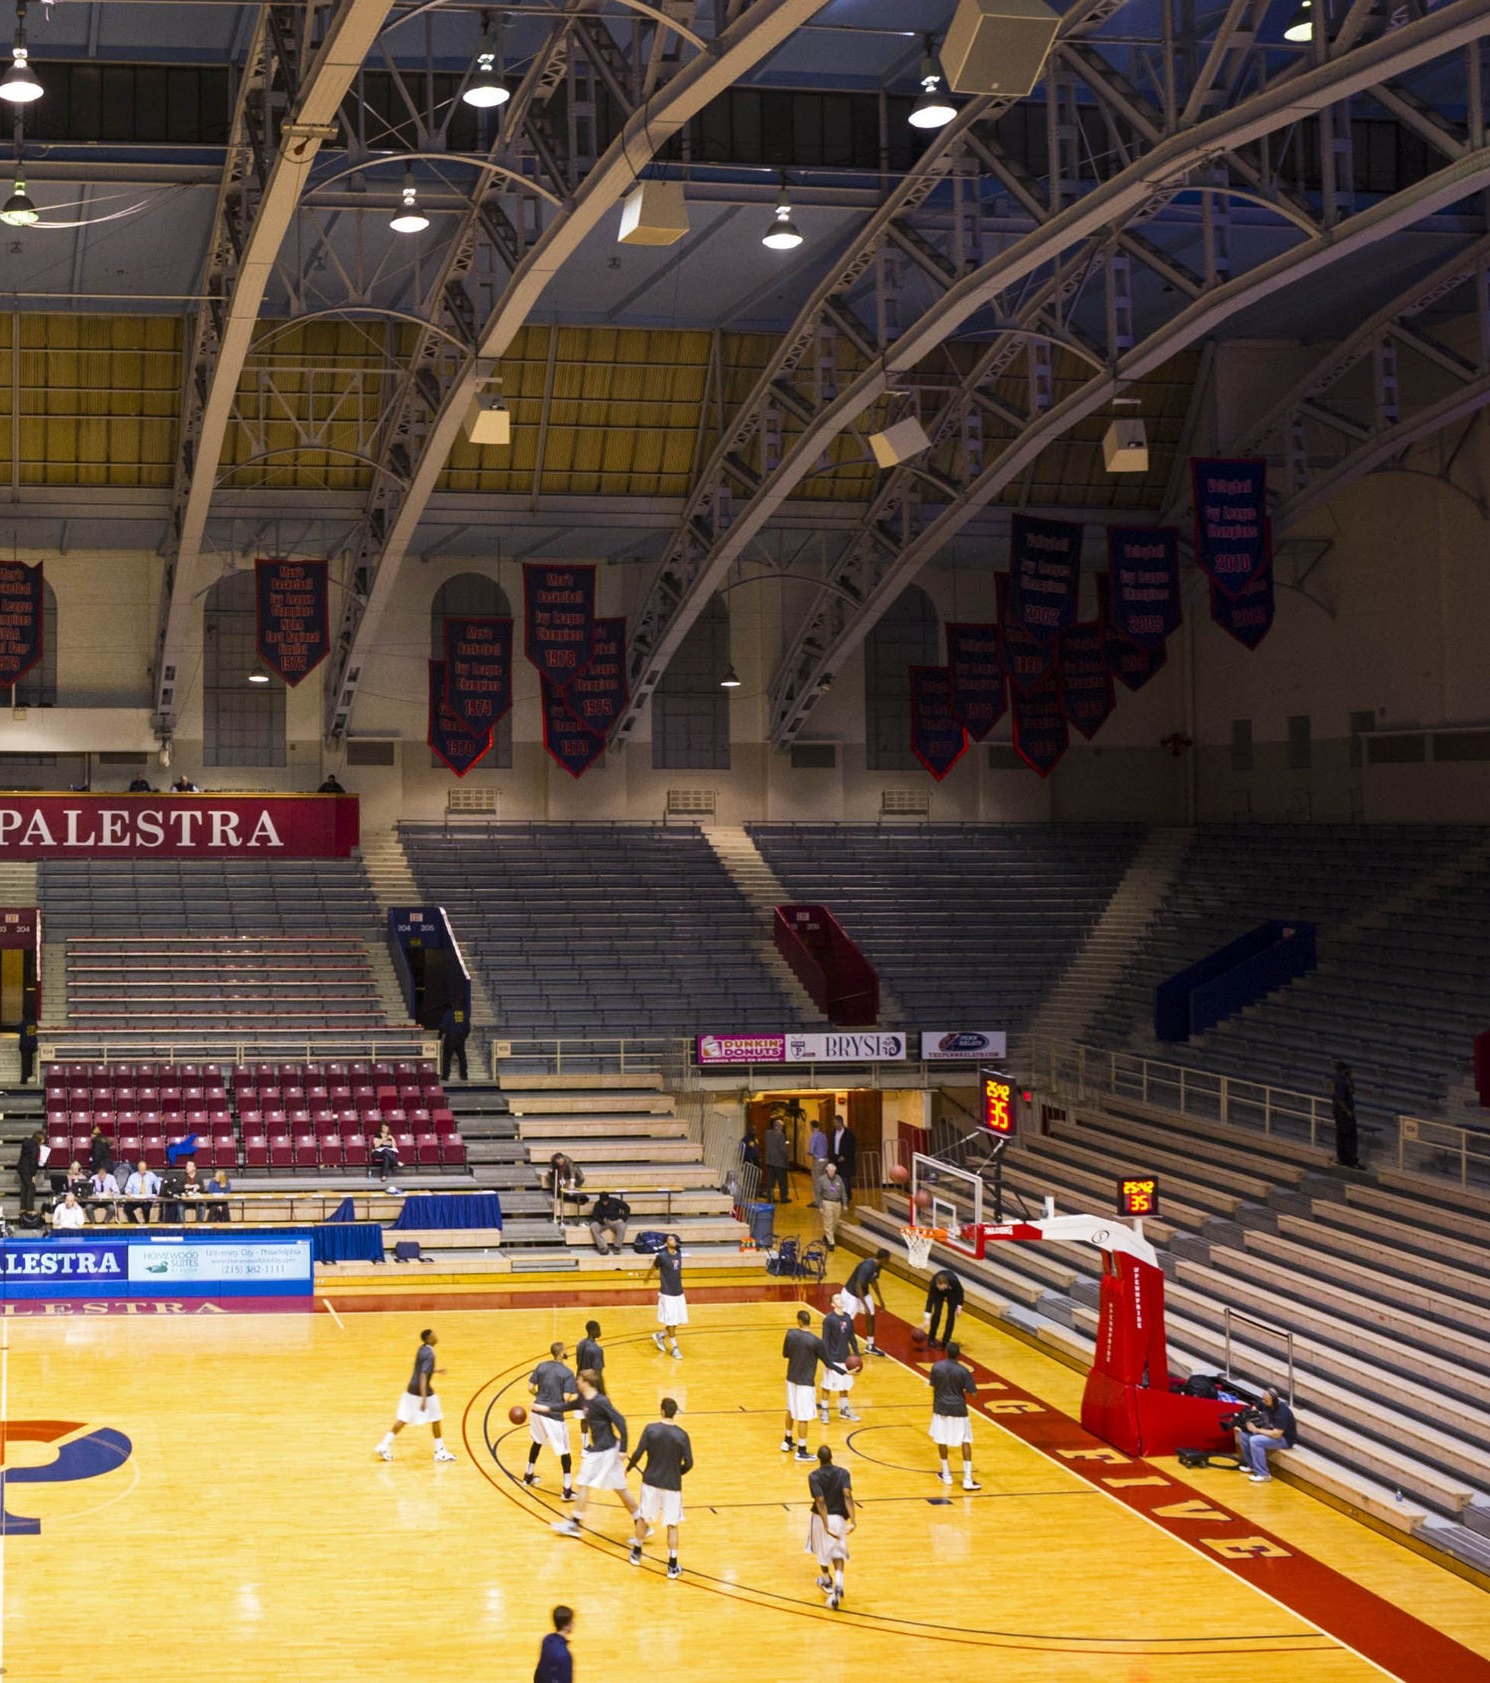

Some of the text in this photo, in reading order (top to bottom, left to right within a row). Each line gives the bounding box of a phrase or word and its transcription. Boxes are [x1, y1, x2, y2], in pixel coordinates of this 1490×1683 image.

[545, 649, 576, 668] 1978
[723, 1039, 783, 1049] DUNKIN'
[724, 1048, 780, 1057] DONUTS
[986, 1080, 1010, 1101] 25:42
[989, 1099, 1009, 1129] 35
[1122, 1181, 1154, 1195] 25:42
[1130, 1195, 1149, 1211] 35
[143, 1251, 199, 1260] HOMEWOOD
[240, 1249, 254, 1258] City
[260, 1248, 301, 1258] Philadelphia
[171, 1259, 199, 1268] SUITES
[221, 1264, 243, 1275] (215)
[1054, 1448, 1294, 1560] FIVE
